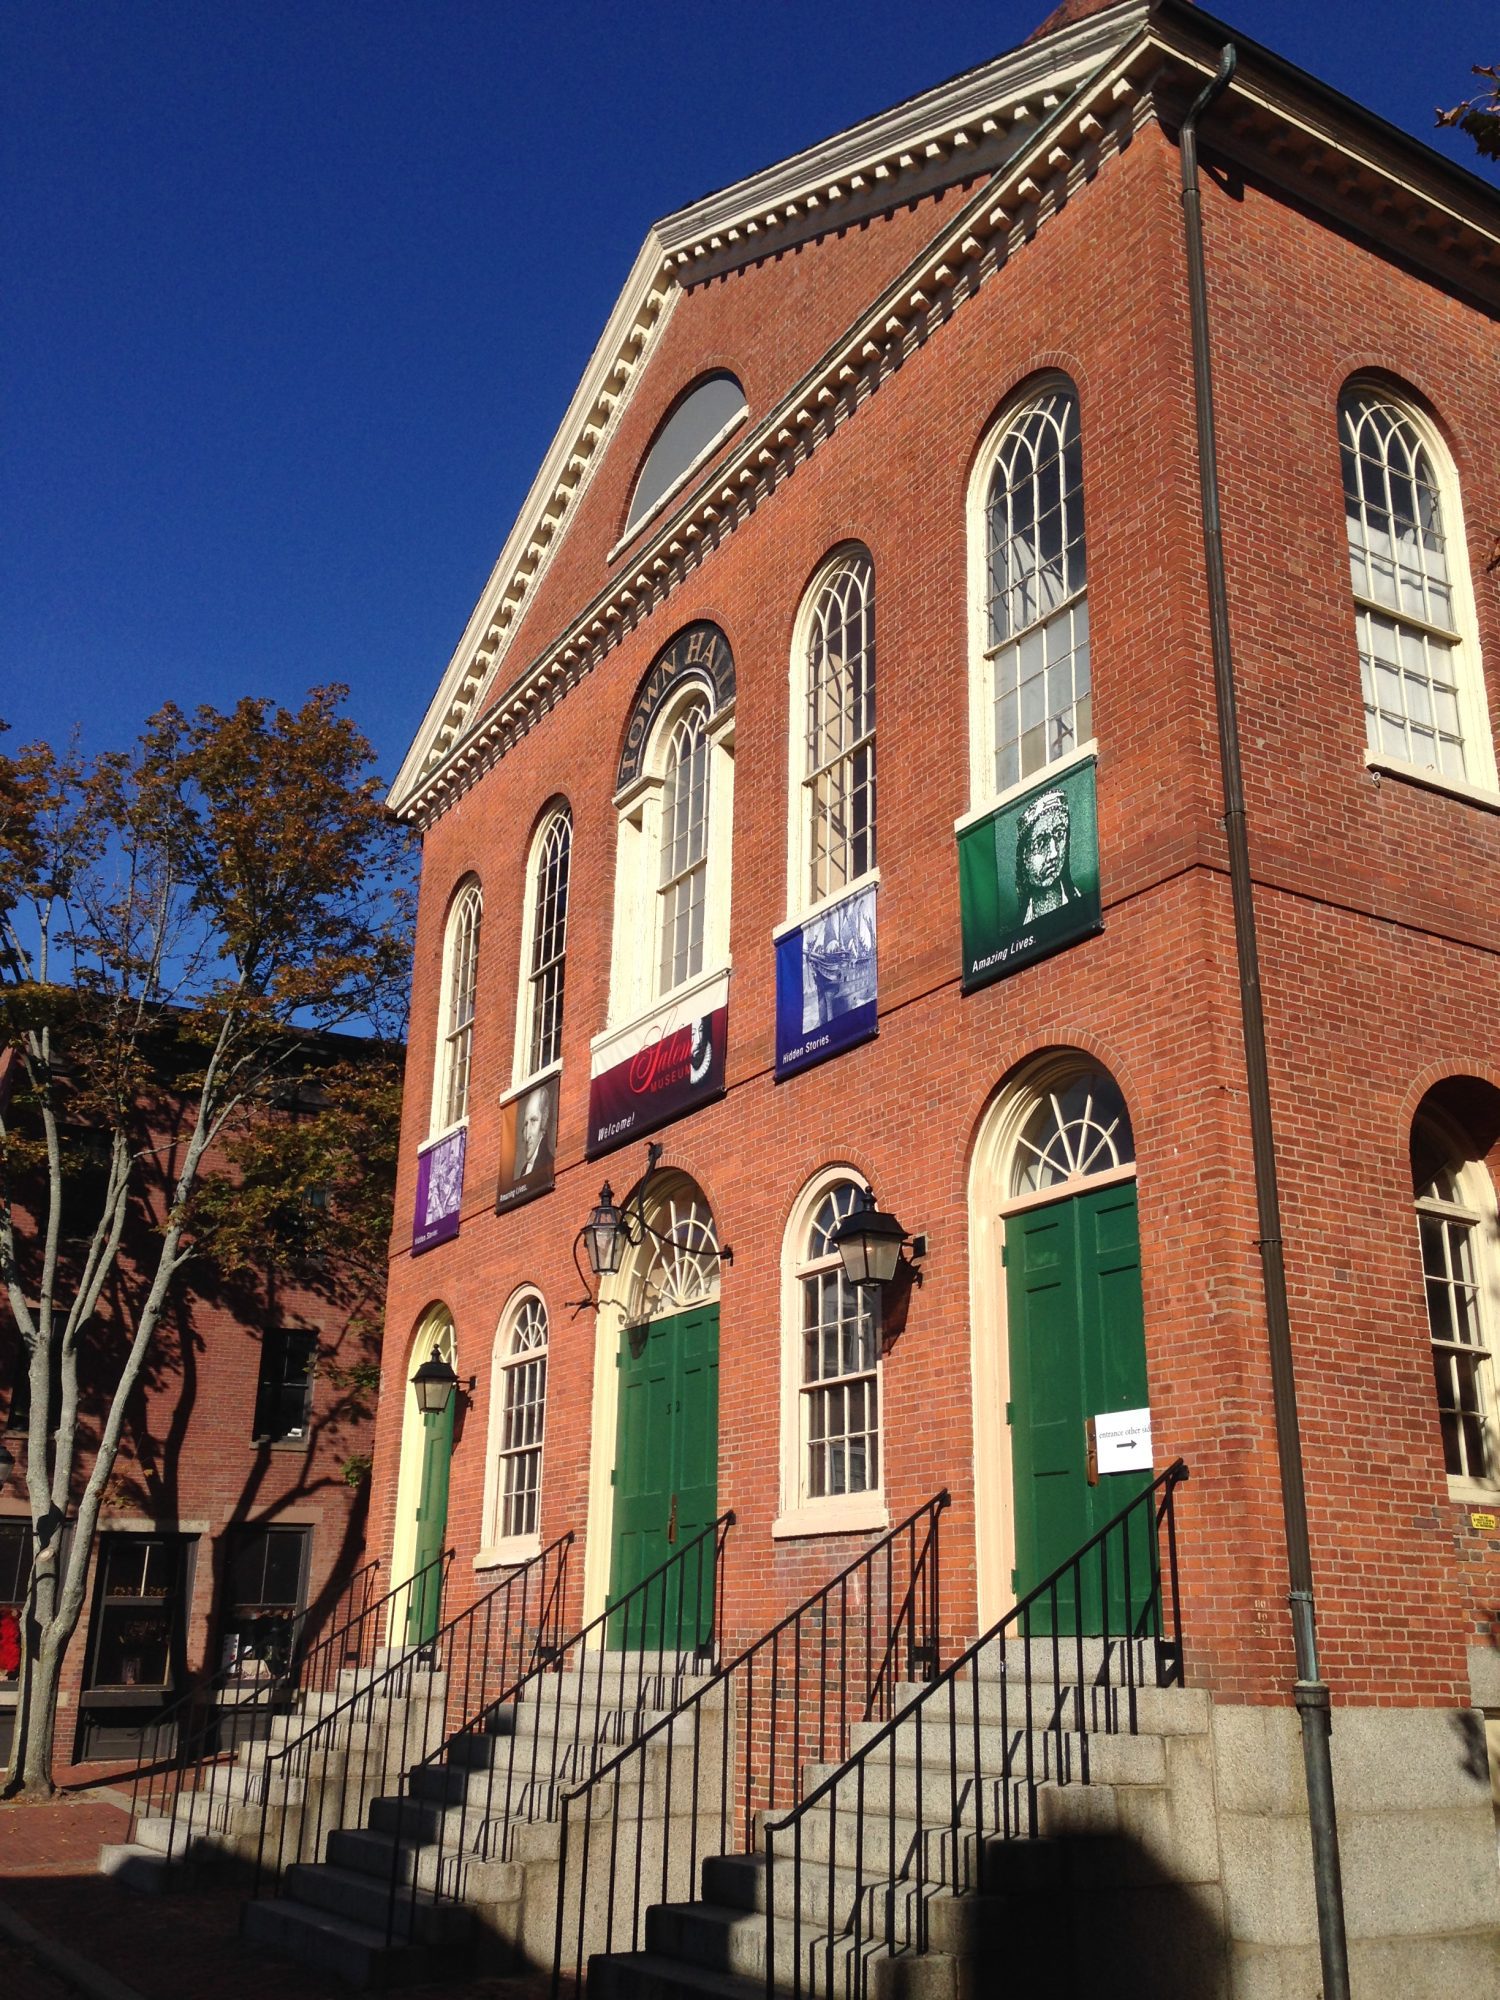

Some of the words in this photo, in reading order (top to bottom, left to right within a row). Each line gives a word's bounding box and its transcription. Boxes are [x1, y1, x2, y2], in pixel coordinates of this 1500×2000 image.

[621, 648, 676, 778] TOWN
[685, 631, 734, 700] HALL
[972, 948, 1008, 973] Amazing
[783, 1047, 804, 1064] Hidden
[651, 1065, 691, 1092] MUSEUM
[598, 1111, 635, 1141] Welcome!
[1099, 1431, 1124, 1439] entrance
[1125, 1426, 1141, 1436] other
